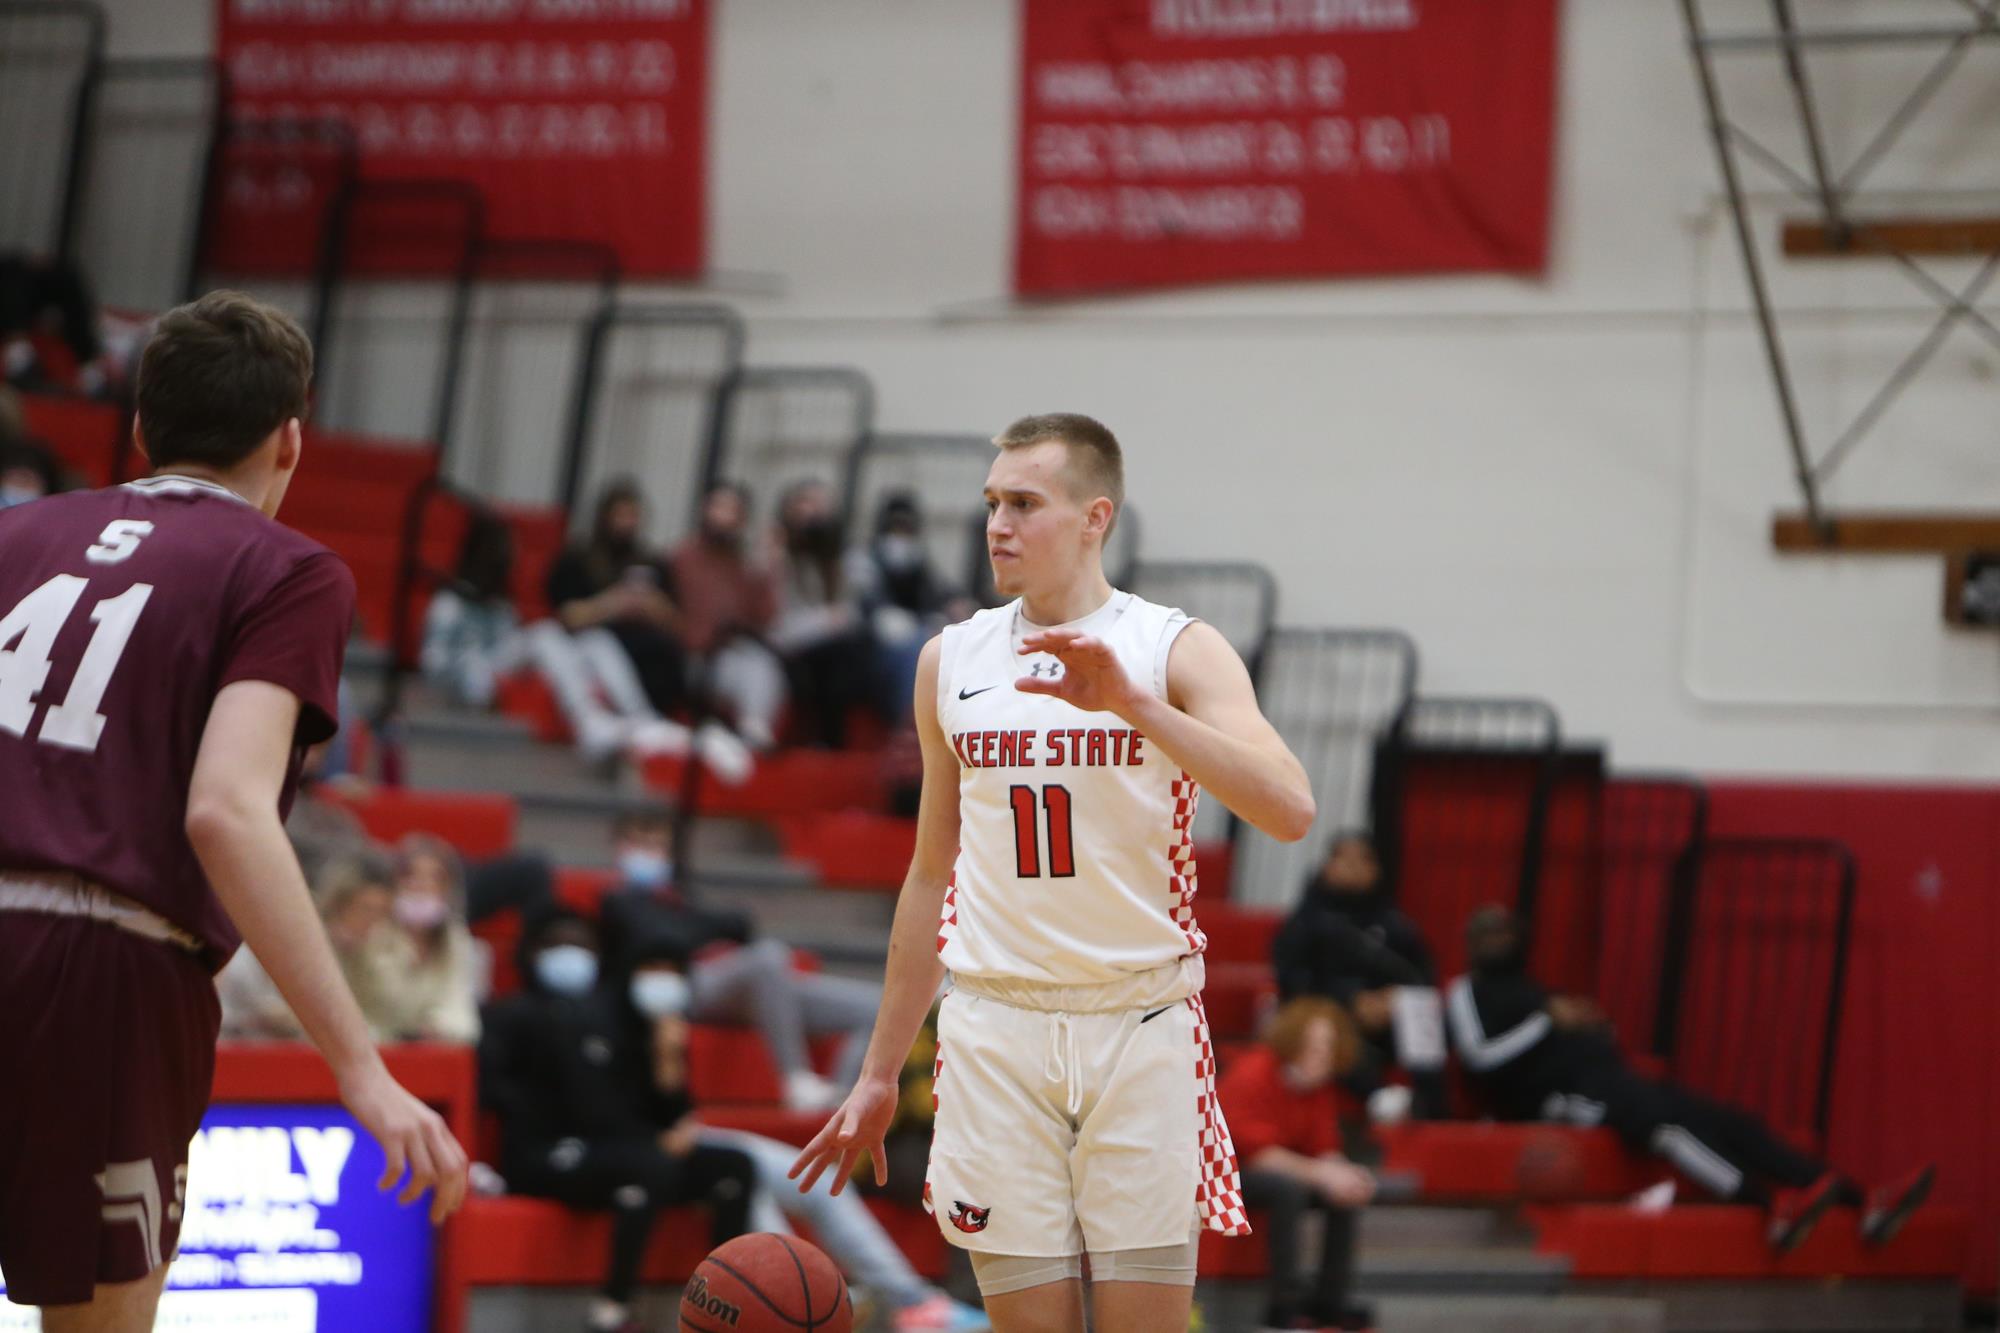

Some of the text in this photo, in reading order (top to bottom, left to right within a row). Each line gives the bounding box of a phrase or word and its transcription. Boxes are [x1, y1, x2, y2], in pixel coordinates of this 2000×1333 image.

[86, 519, 155, 564] S
[0, 573, 154, 753] 41
[952, 728, 1146, 768] KEENE STATE
[1010, 784, 1076, 878] 11
[684, 1274, 741, 1326] ilson
